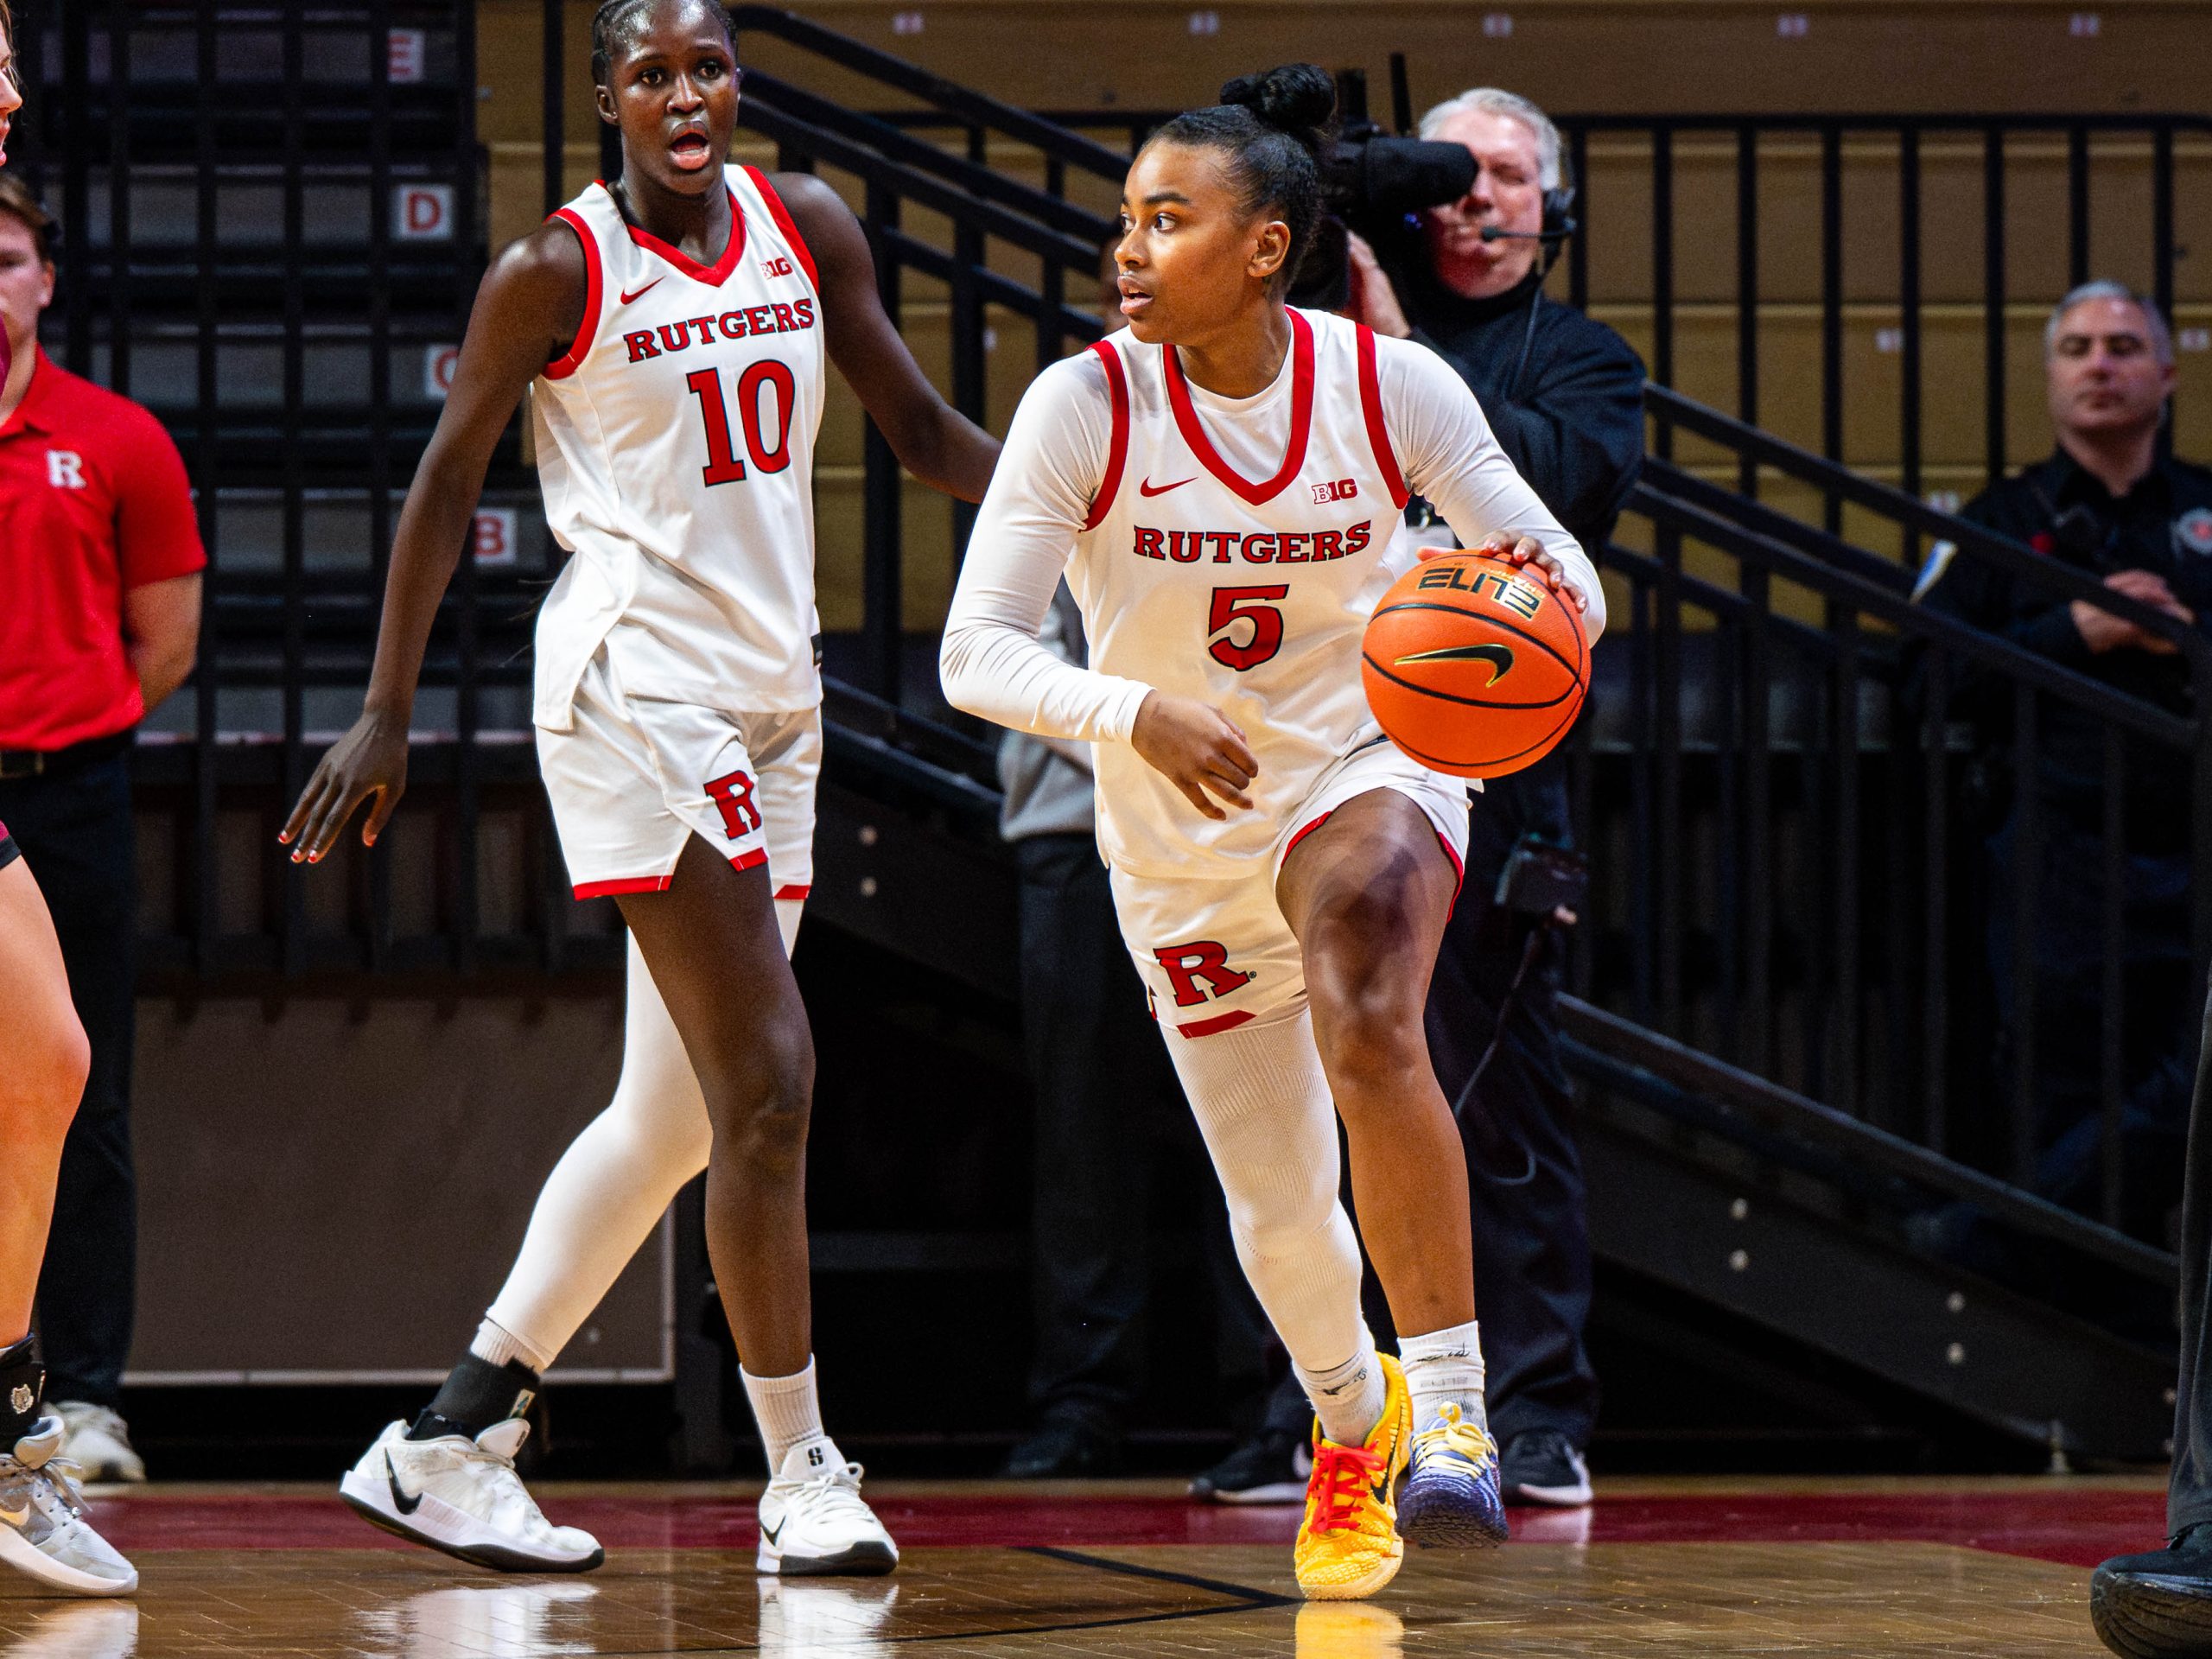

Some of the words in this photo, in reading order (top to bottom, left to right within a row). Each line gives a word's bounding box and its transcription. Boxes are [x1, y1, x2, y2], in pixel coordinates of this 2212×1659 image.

[407, 193, 442, 232] D
[623, 298, 815, 363] RUTGERS
[685, 359, 795, 487] 10
[46, 449, 87, 489] R
[475, 516, 505, 555] B
[1133, 519, 1371, 563] RUTGERS
[1417, 567, 1541, 620] ELITE
[1208, 583, 1290, 671] 5
[702, 769, 762, 841] R
[1153, 940, 1250, 1007] R
